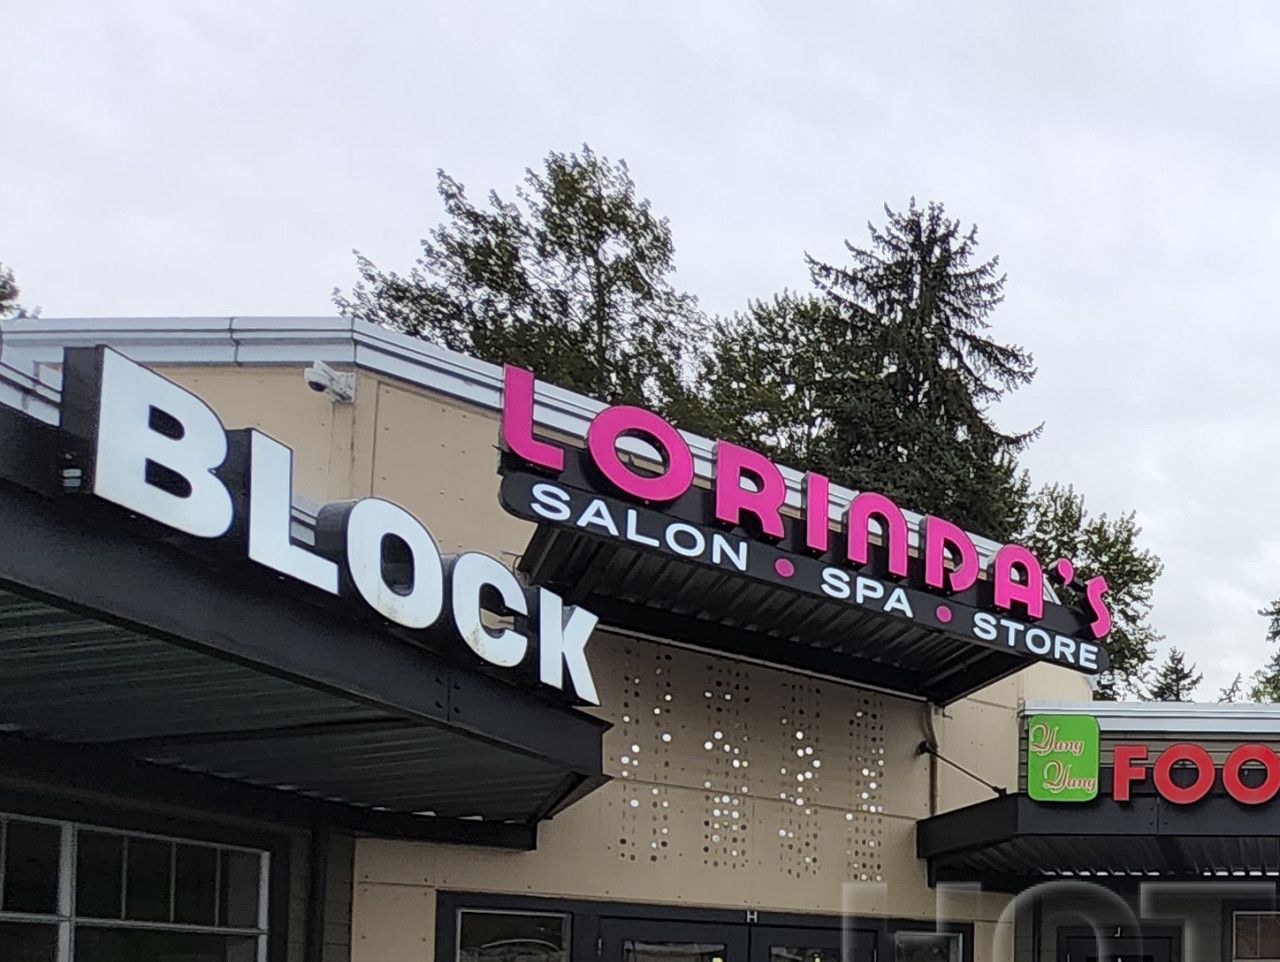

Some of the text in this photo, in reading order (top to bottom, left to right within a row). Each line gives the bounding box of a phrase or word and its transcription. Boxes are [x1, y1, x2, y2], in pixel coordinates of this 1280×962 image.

[94, 344, 600, 706] BLOCK
[530, 483, 1099, 671] SALON SPA STORE
[1030, 722, 1085, 757] Yang
[1043, 759, 1098, 794] Yang
[747, 910, 758, 923] H
